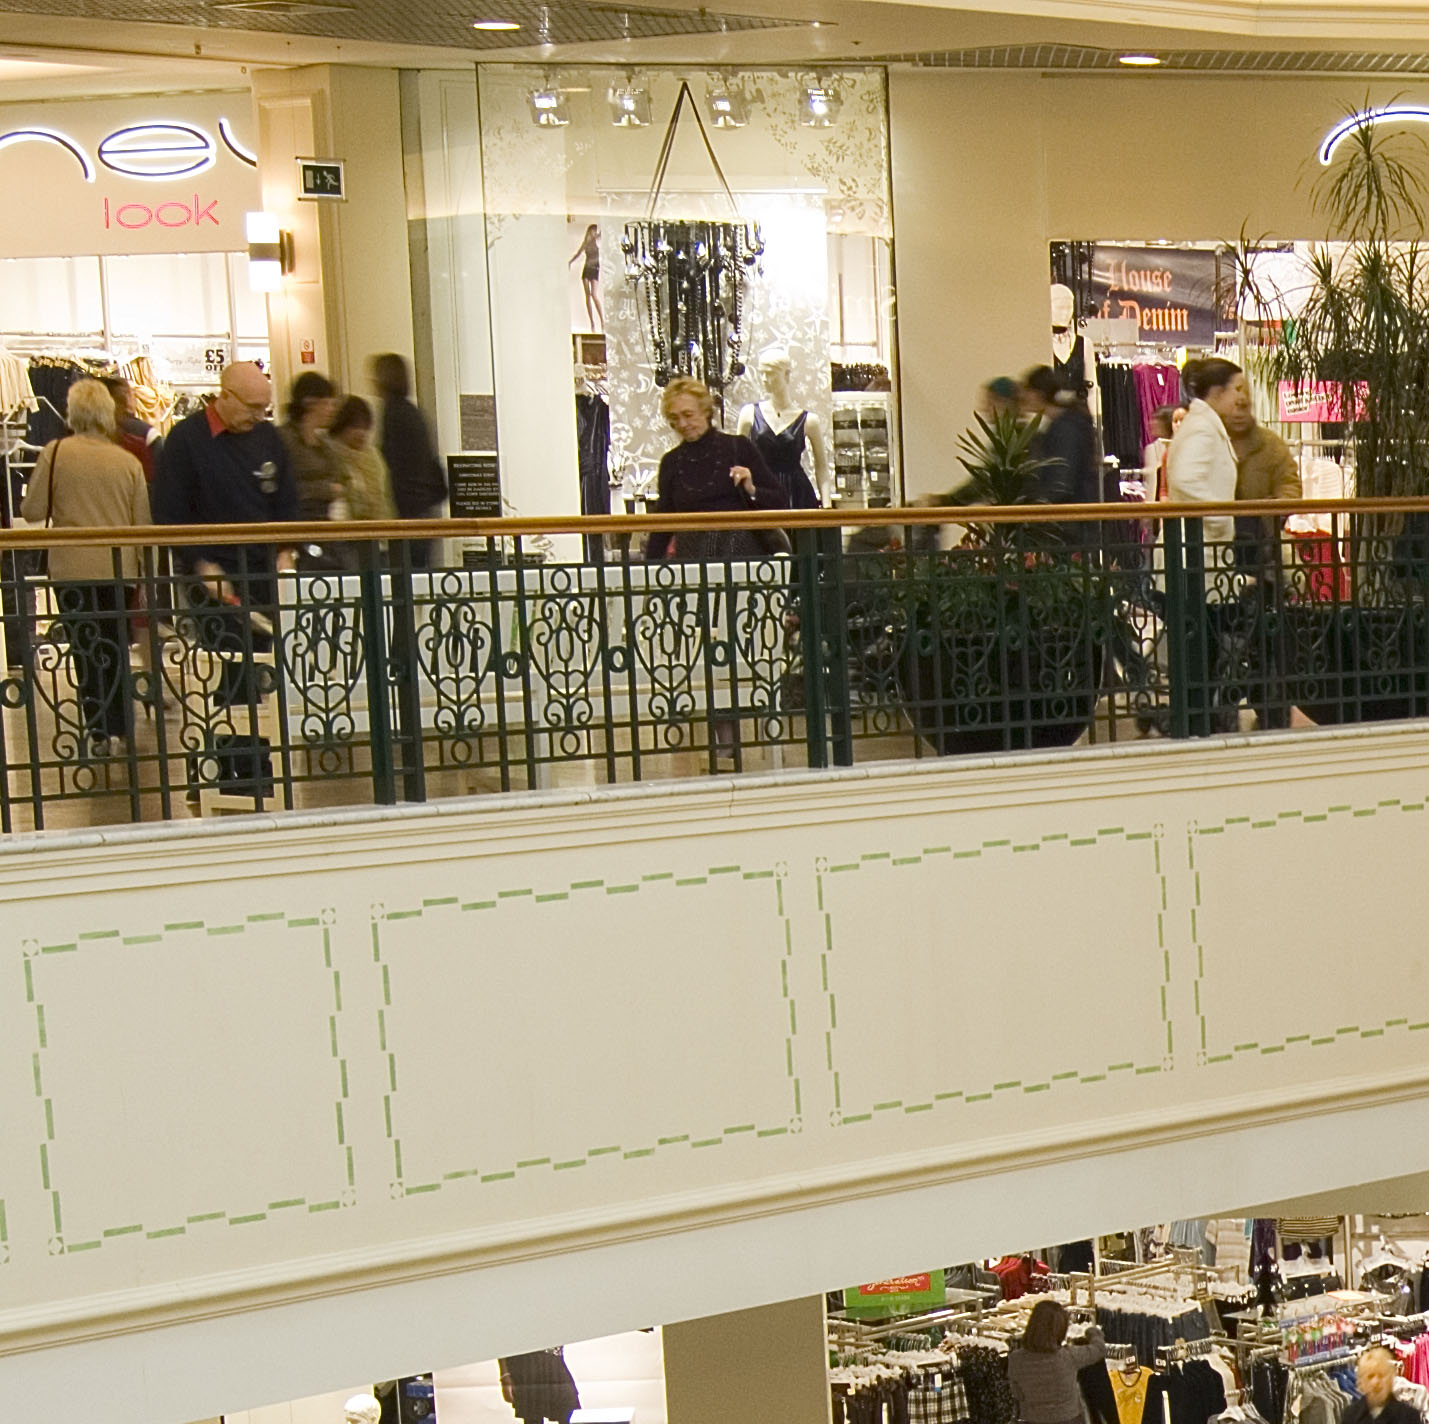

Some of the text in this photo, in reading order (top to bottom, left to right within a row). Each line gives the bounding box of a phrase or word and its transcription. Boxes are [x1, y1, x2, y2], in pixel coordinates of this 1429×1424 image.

[103, 193, 219, 230] look
[1106, 259, 1173, 296] House
[1117, 299, 1189, 331] Denim
[205, 349, 225, 364] £5
[206, 364, 225, 372] OFF
